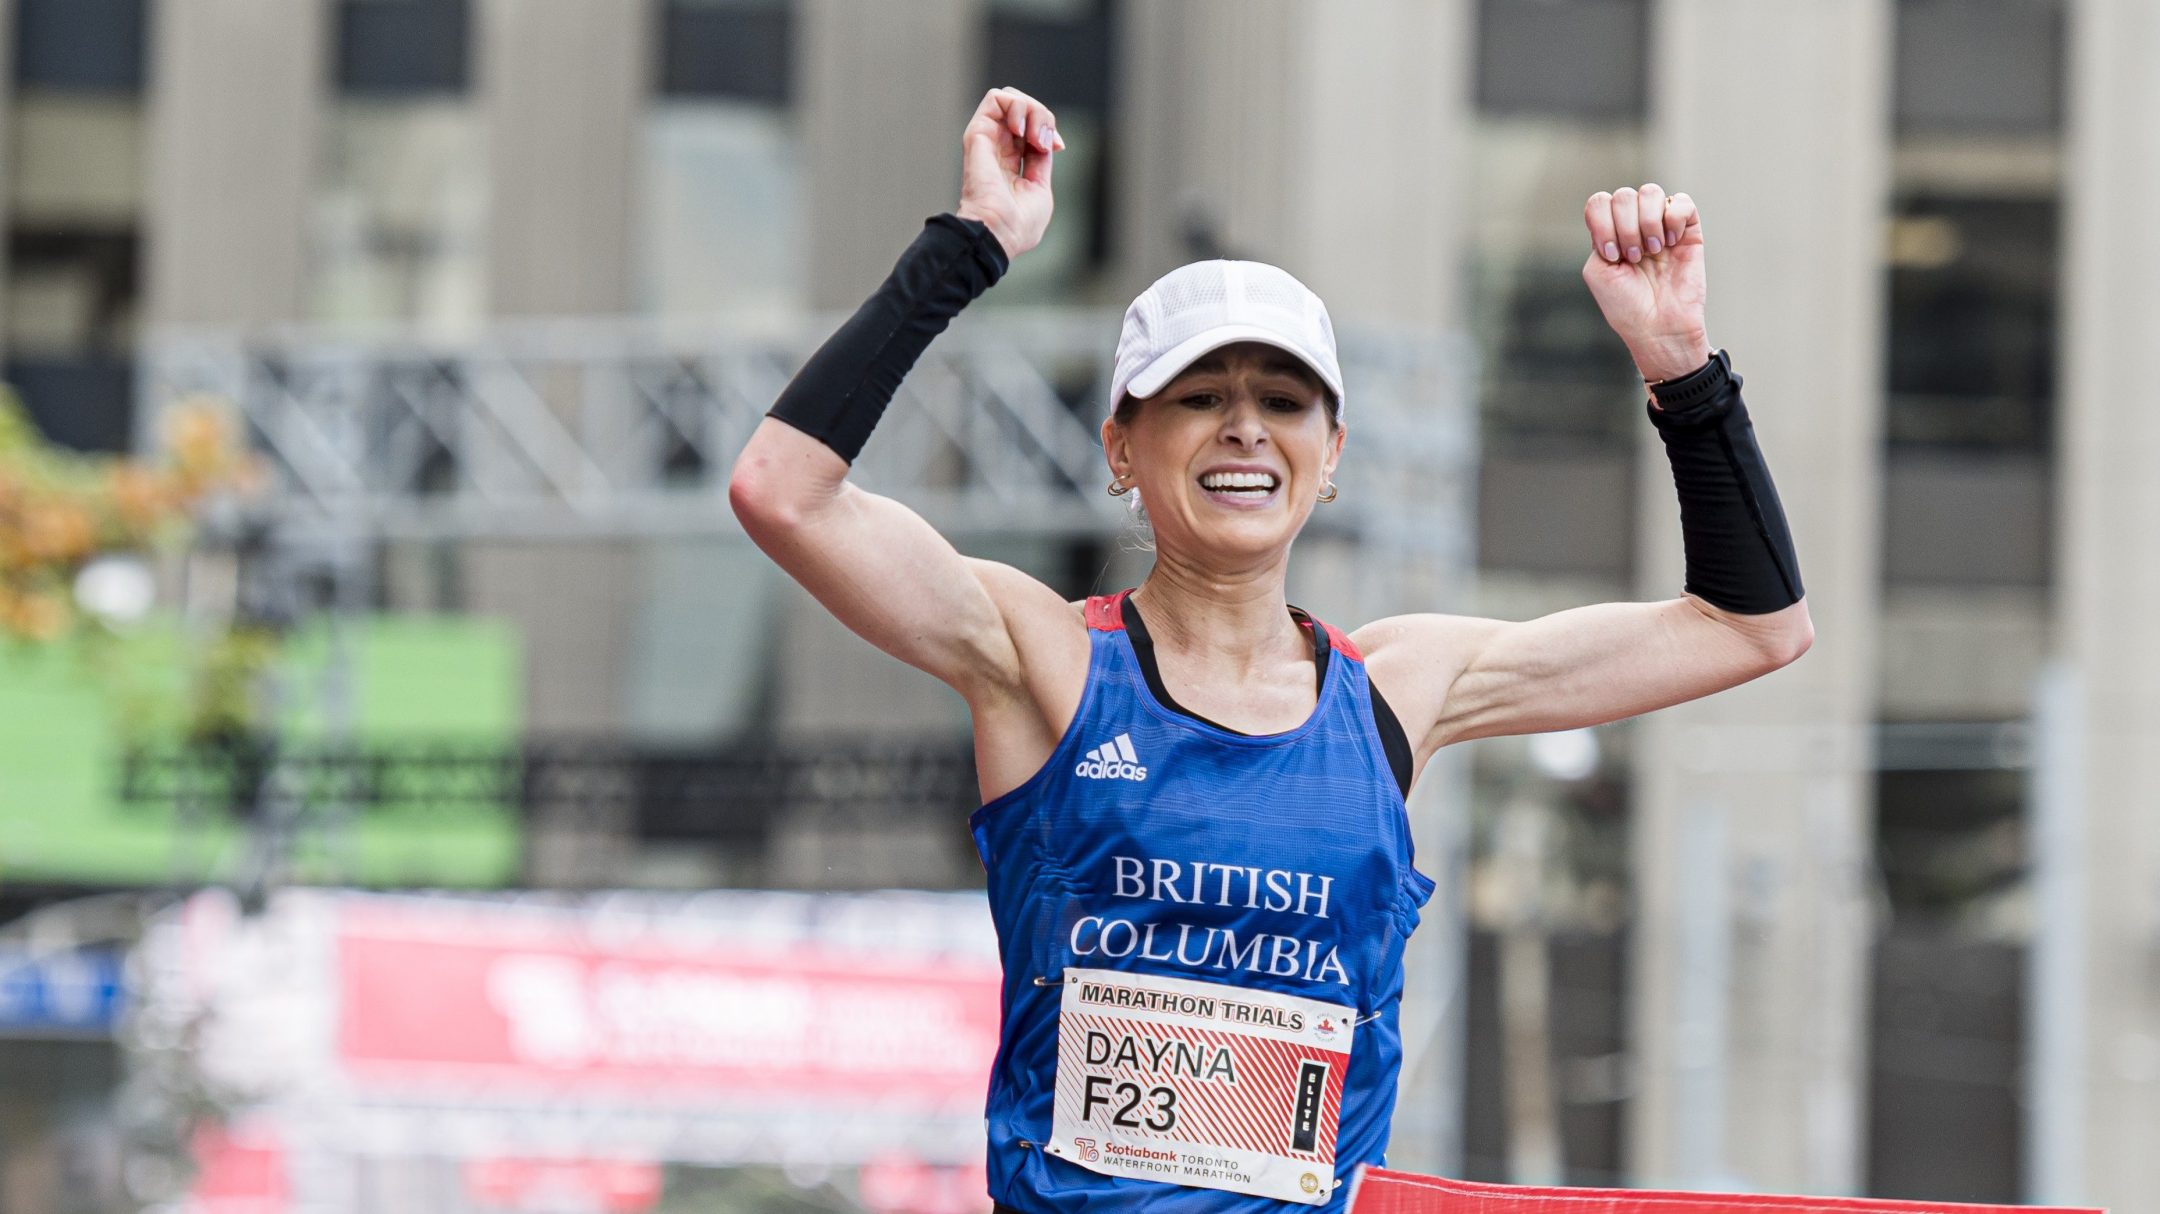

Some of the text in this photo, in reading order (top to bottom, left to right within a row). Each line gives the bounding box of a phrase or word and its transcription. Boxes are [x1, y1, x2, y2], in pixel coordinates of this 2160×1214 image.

[1075, 759, 1147, 782] adidas
[1112, 855, 1335, 919] BRITISH
[1070, 916, 1350, 986] COLUMBIA
[1081, 983, 1214, 1018] MARATHON
[1221, 1003, 1305, 1031] TRIALS
[1085, 1031, 1236, 1083] DAYNA
[1081, 1075, 1178, 1132] F23
[1302, 1072, 1316, 1132] ELITE
[1103, 1156, 1251, 1183] WATERFRONT MARATHON
[1105, 1142, 1239, 1170] Scotiabank TORONTO
